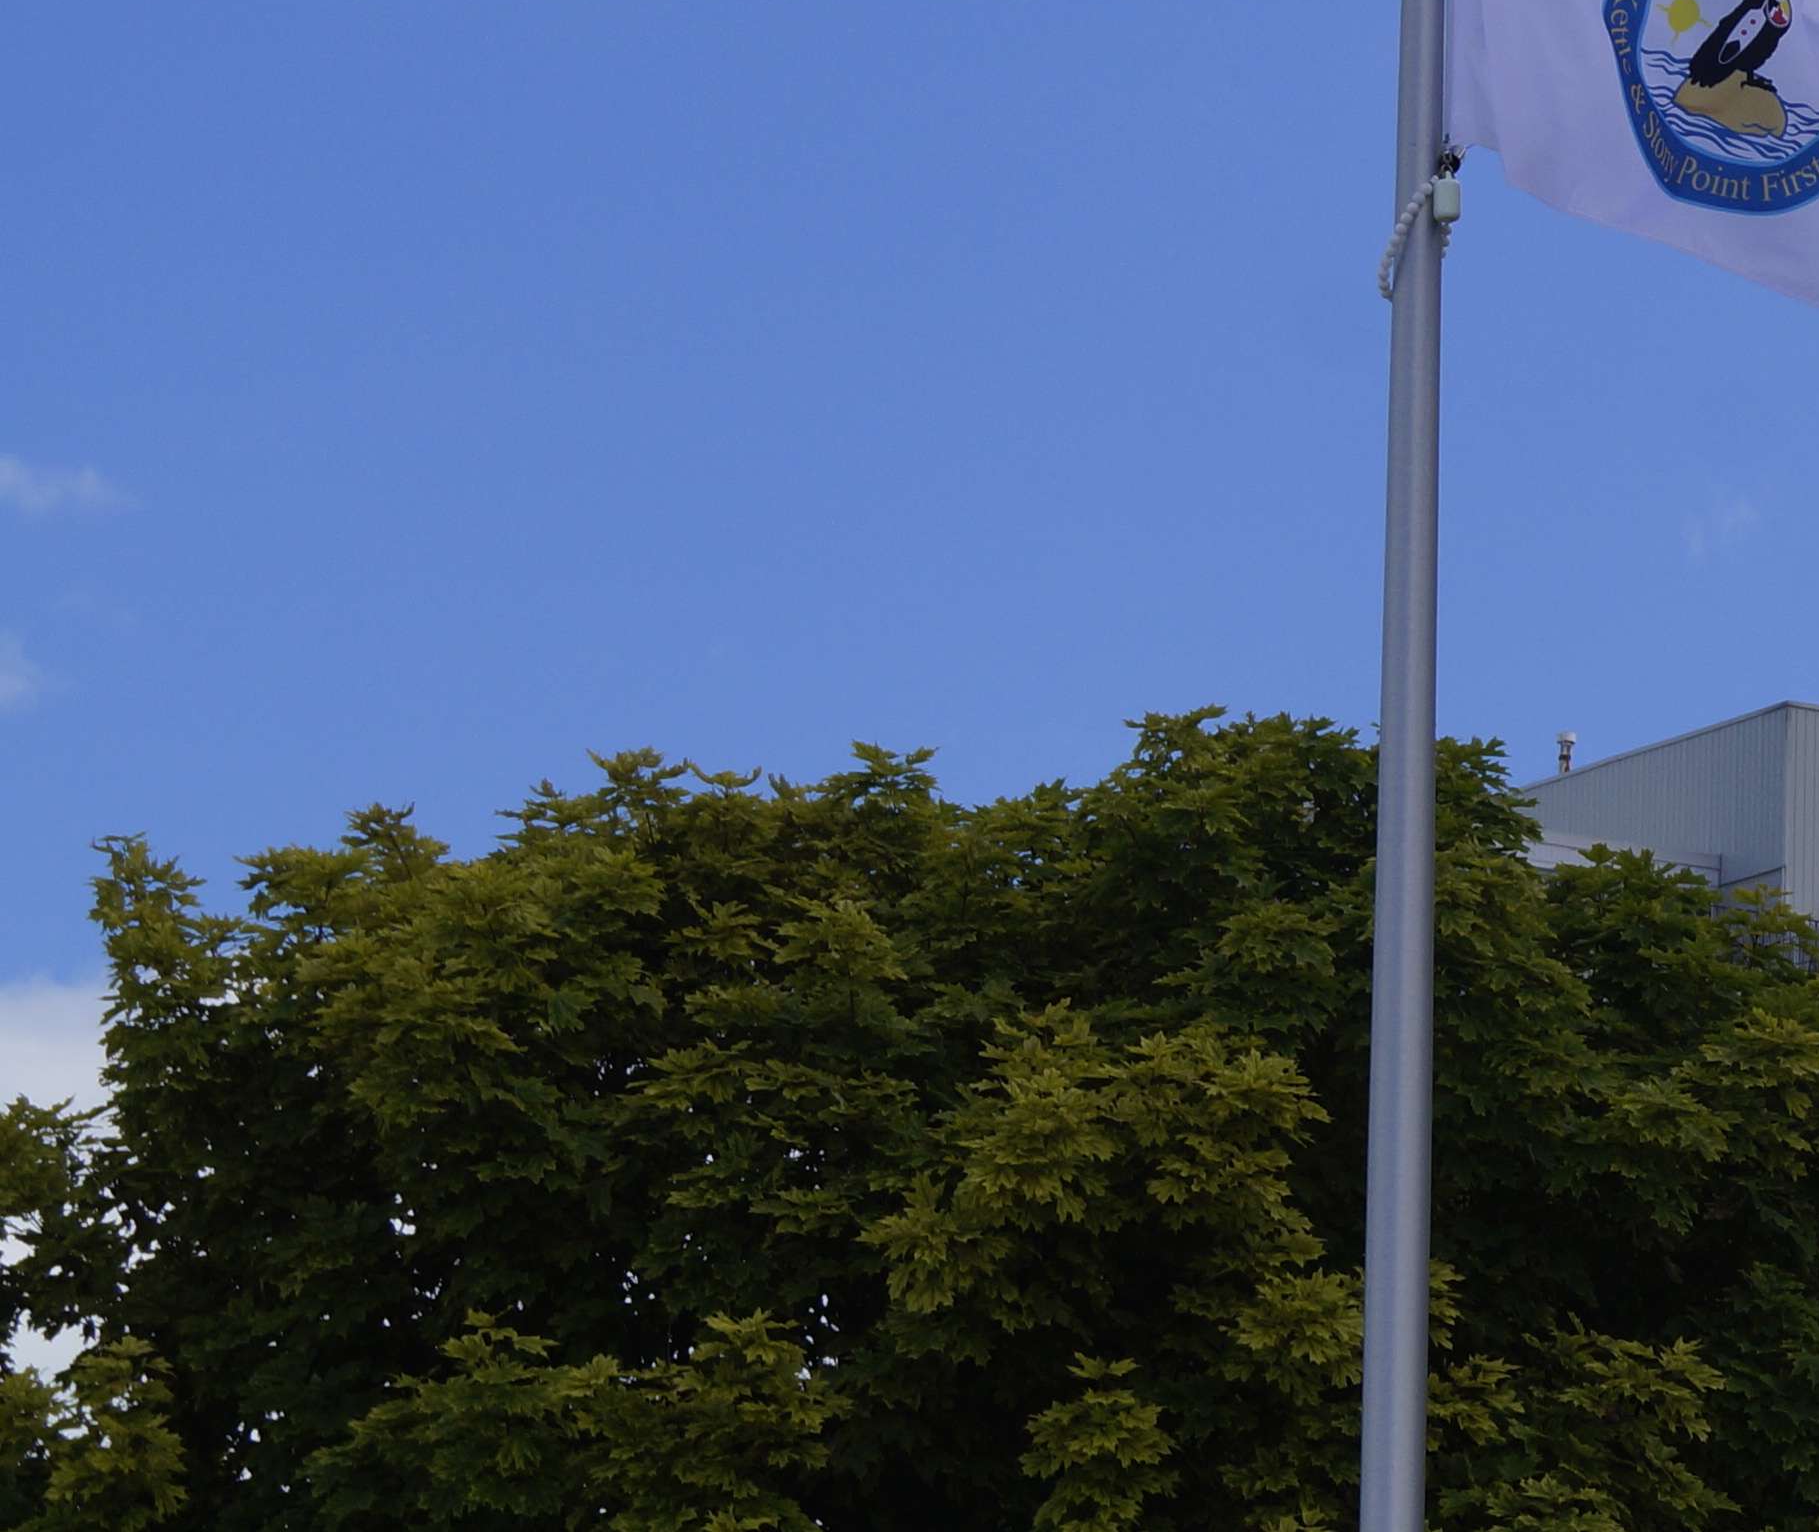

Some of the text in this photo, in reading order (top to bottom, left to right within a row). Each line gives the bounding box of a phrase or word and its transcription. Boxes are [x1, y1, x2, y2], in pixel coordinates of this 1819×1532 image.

[1630, 84, 1647, 114] &
[1643, 112, 1678, 183] Stony
[1676, 155, 1751, 201] Point
